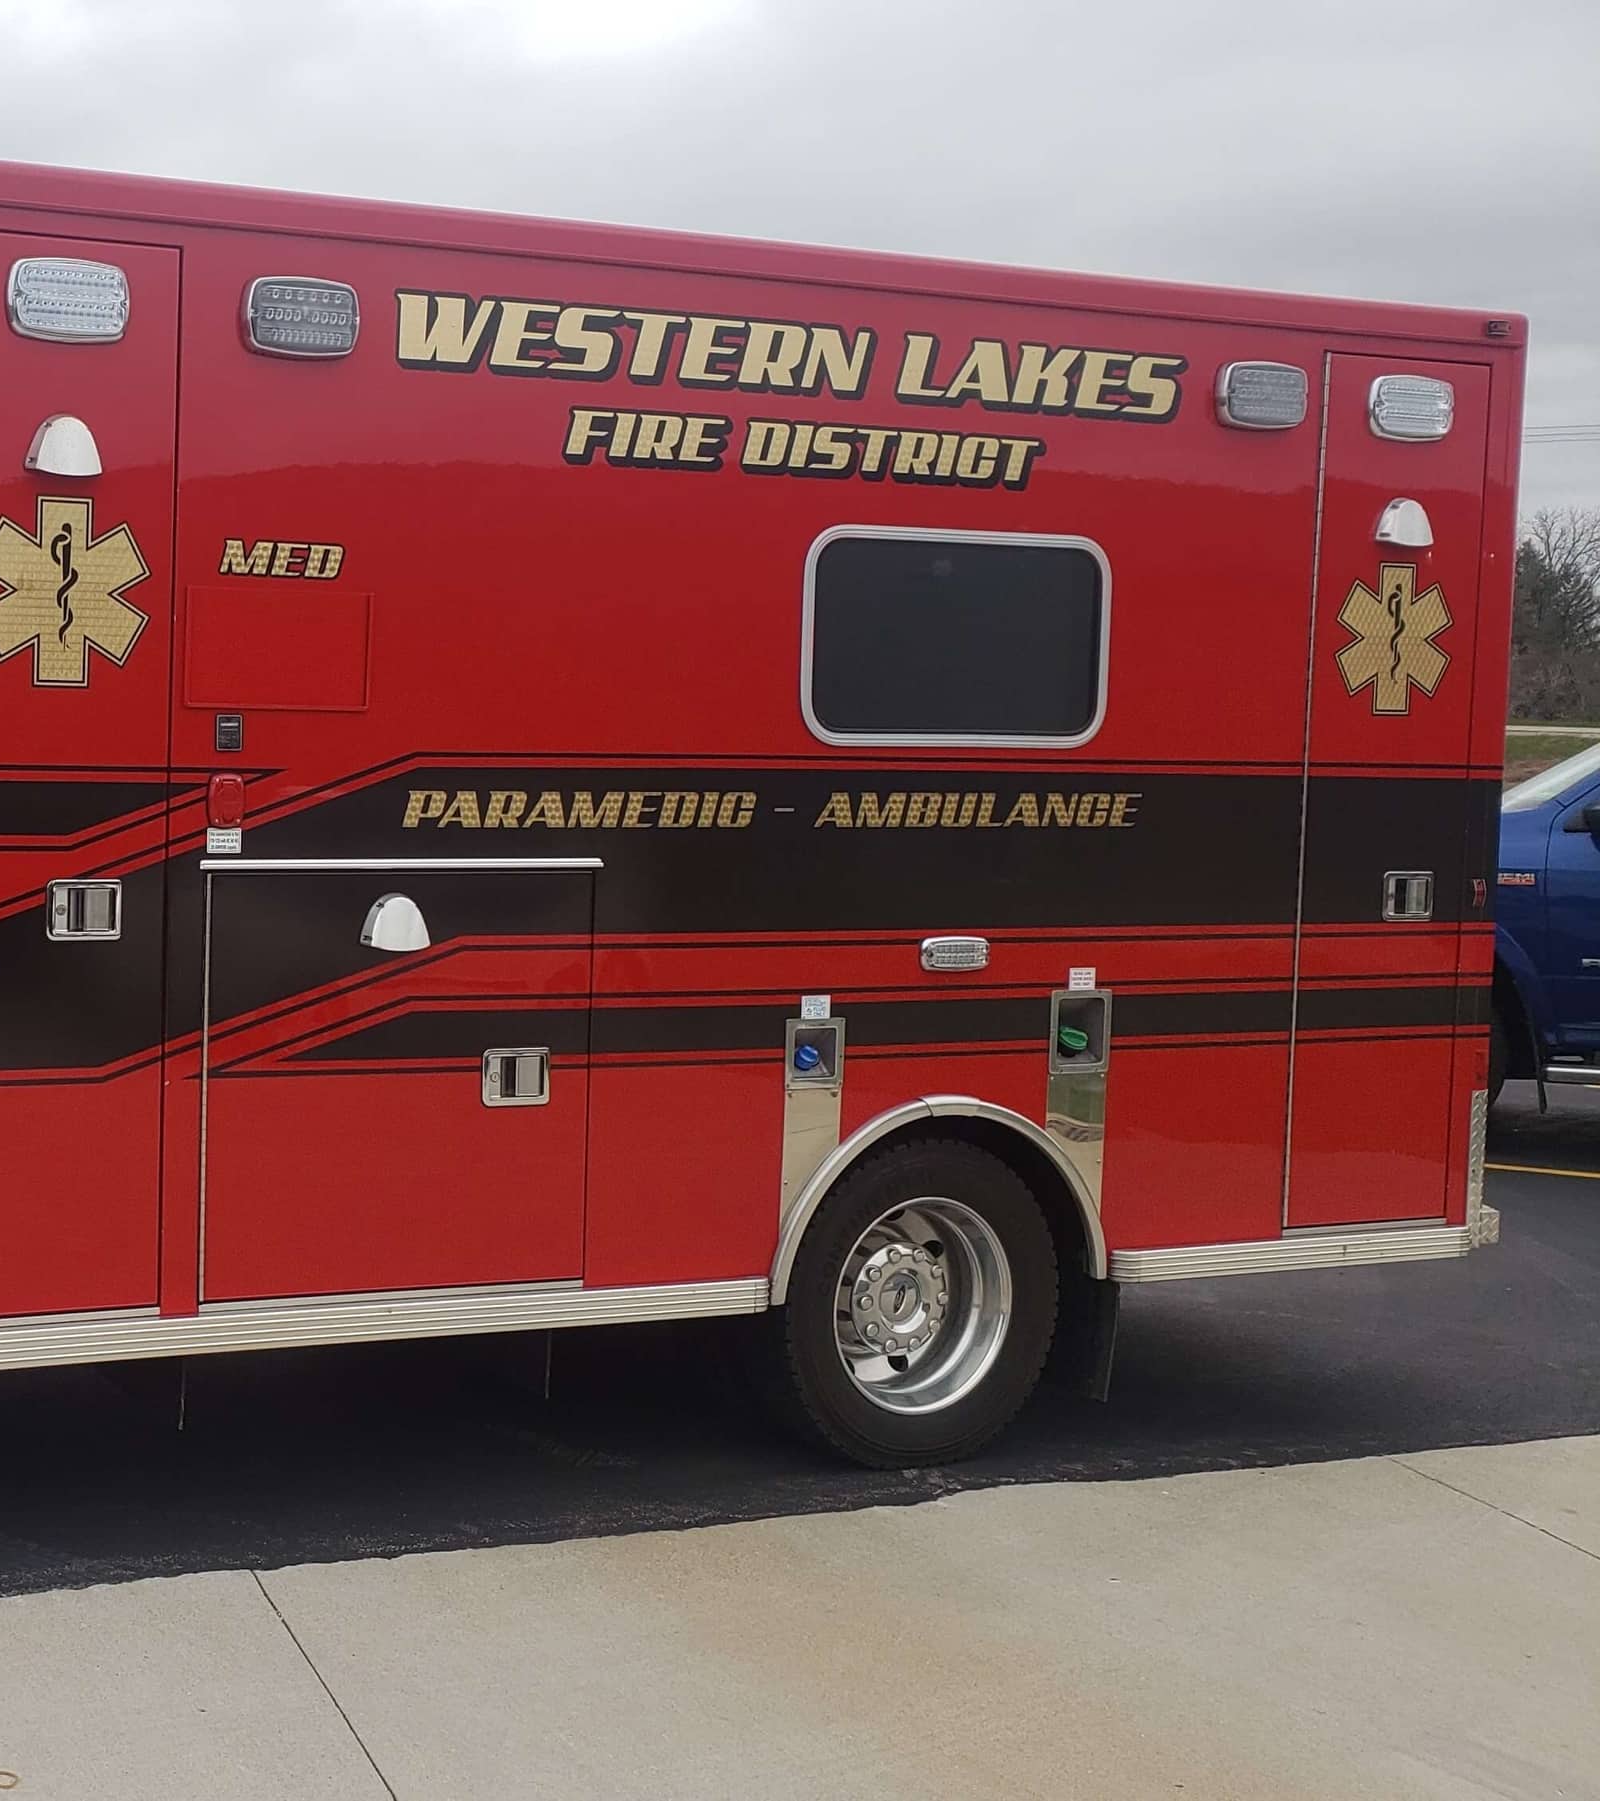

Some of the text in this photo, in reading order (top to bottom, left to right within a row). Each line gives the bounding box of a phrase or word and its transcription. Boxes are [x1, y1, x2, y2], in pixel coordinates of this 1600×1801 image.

[396, 289, 1188, 423] WESTERN LAKES
[562, 405, 1046, 491] FIRE DISTRICT
[219, 539, 344, 579] MED
[402, 790, 757, 828] PARAMEDIC
[813, 792, 1143, 828] AMBULANCE
